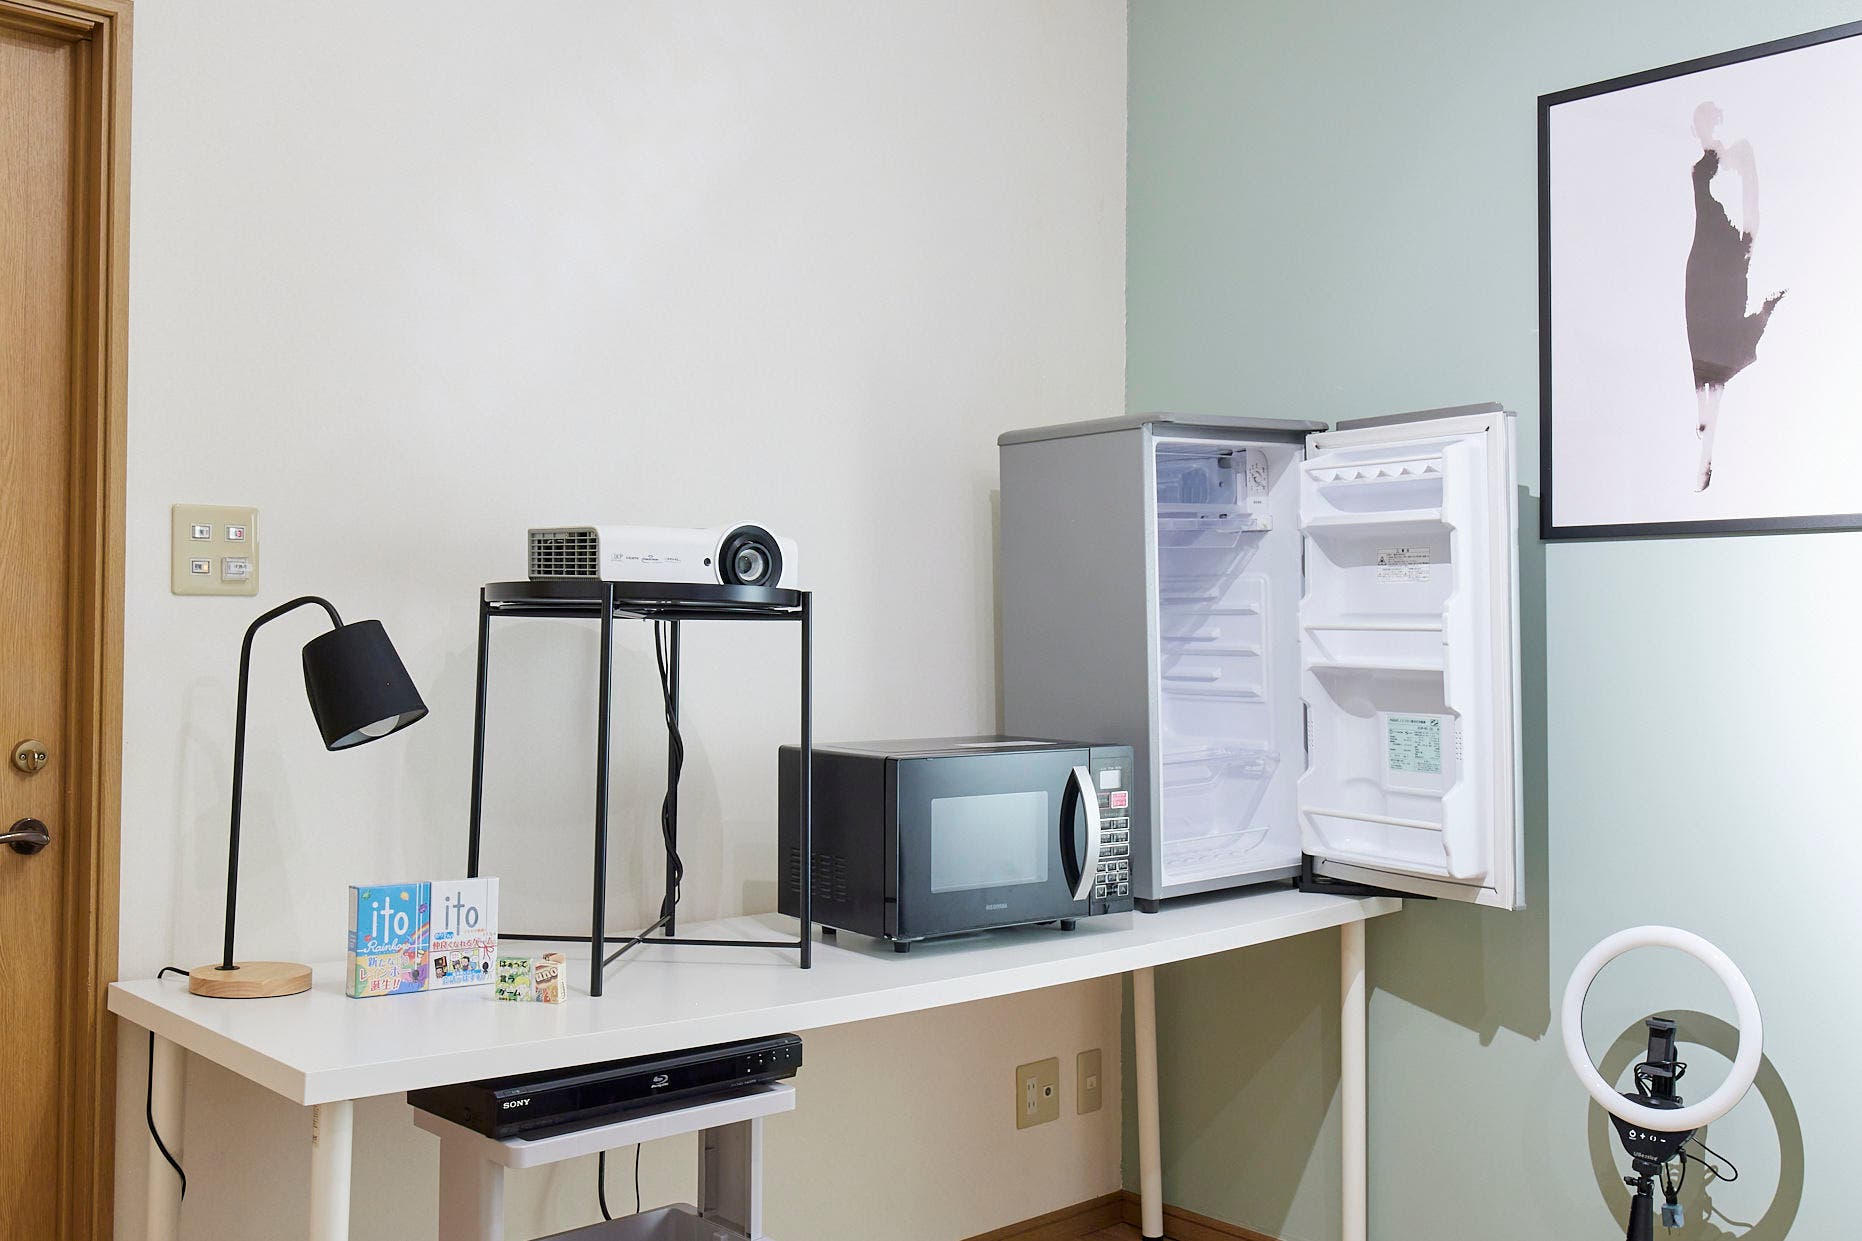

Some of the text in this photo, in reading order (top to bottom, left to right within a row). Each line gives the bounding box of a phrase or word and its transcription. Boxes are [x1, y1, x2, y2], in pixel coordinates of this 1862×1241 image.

[372, 896, 409, 943] ito
[445, 891, 479, 936] ito
[535, 967, 558, 982] uno
[499, 988, 521, 997] ゲーム
[503, 1098, 531, 1110] SONY
